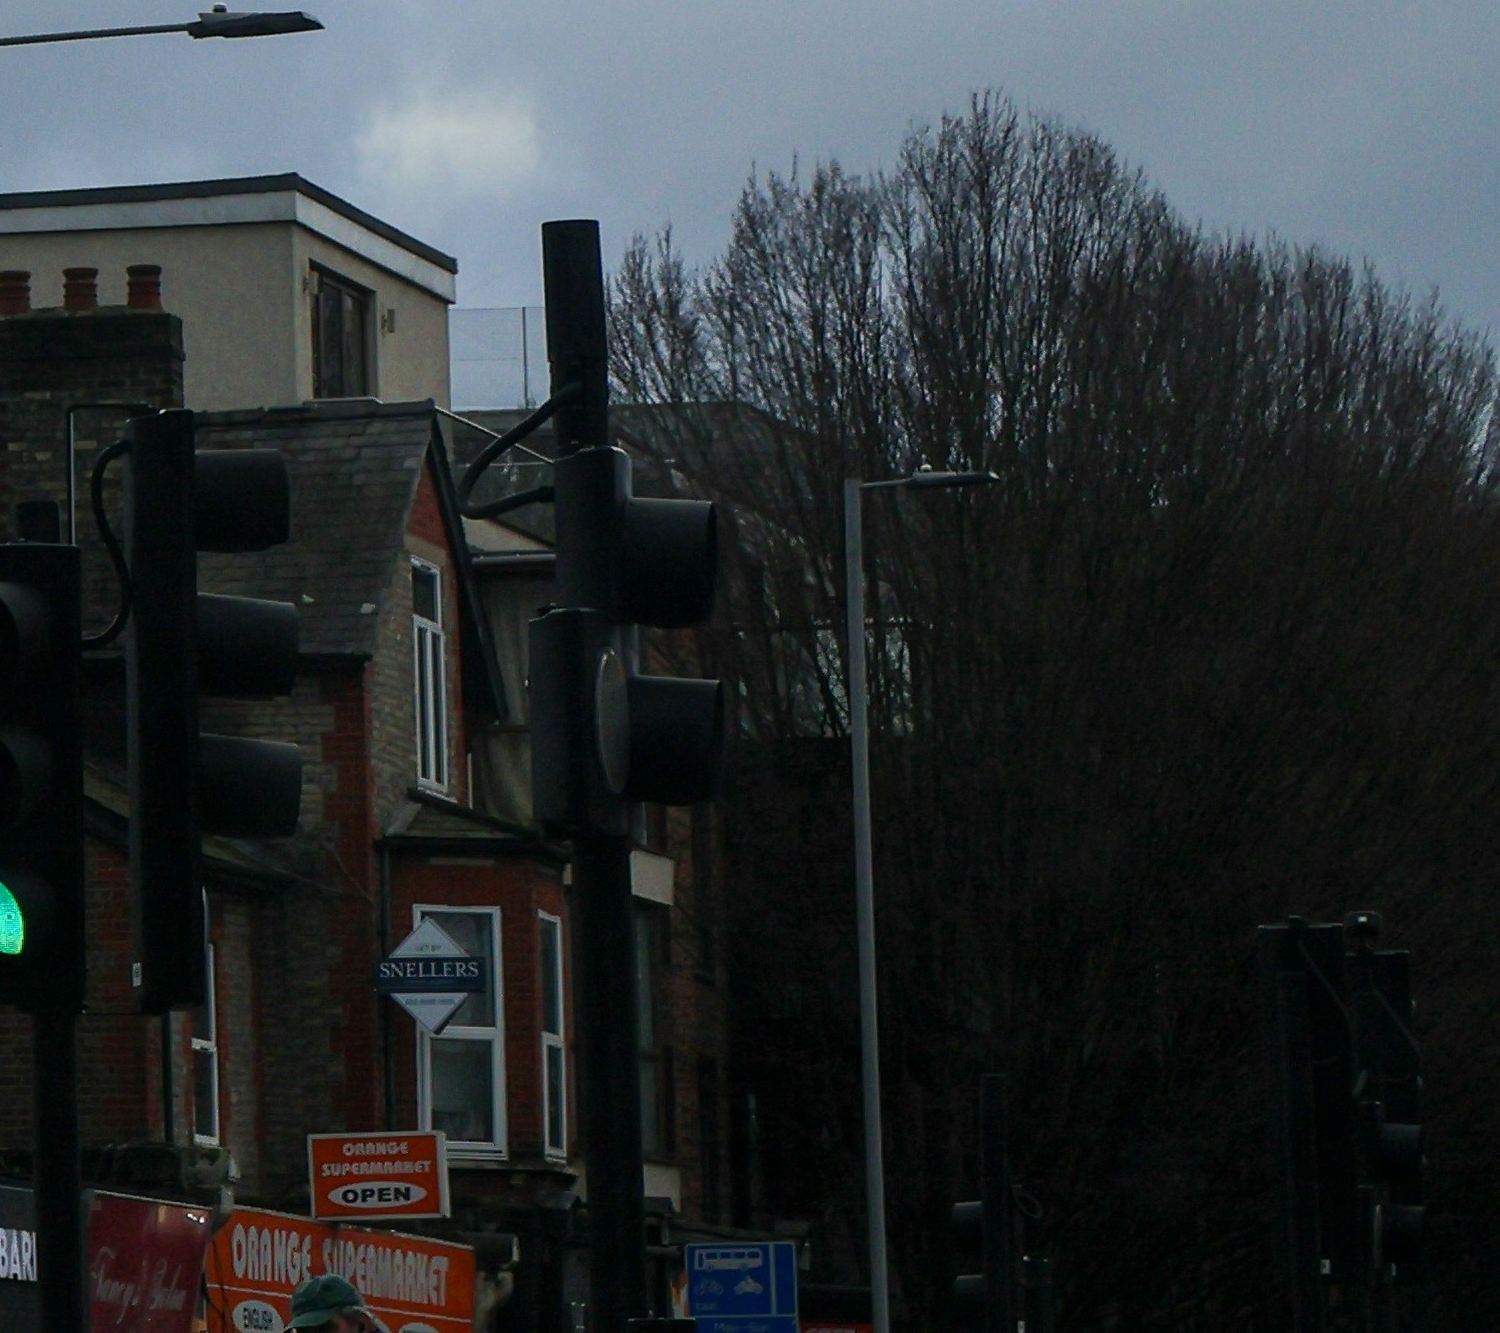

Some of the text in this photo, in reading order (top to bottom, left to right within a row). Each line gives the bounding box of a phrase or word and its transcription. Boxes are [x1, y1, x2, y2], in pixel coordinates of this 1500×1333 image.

[379, 961, 479, 978] SNELLERS
[342, 1141, 409, 1157] ORANGE
[321, 1159, 432, 1176] SUPERMARKET
[341, 1186, 411, 1203] OPEN
[231, 1222, 450, 1307] ORANGE SUPERMARKET
